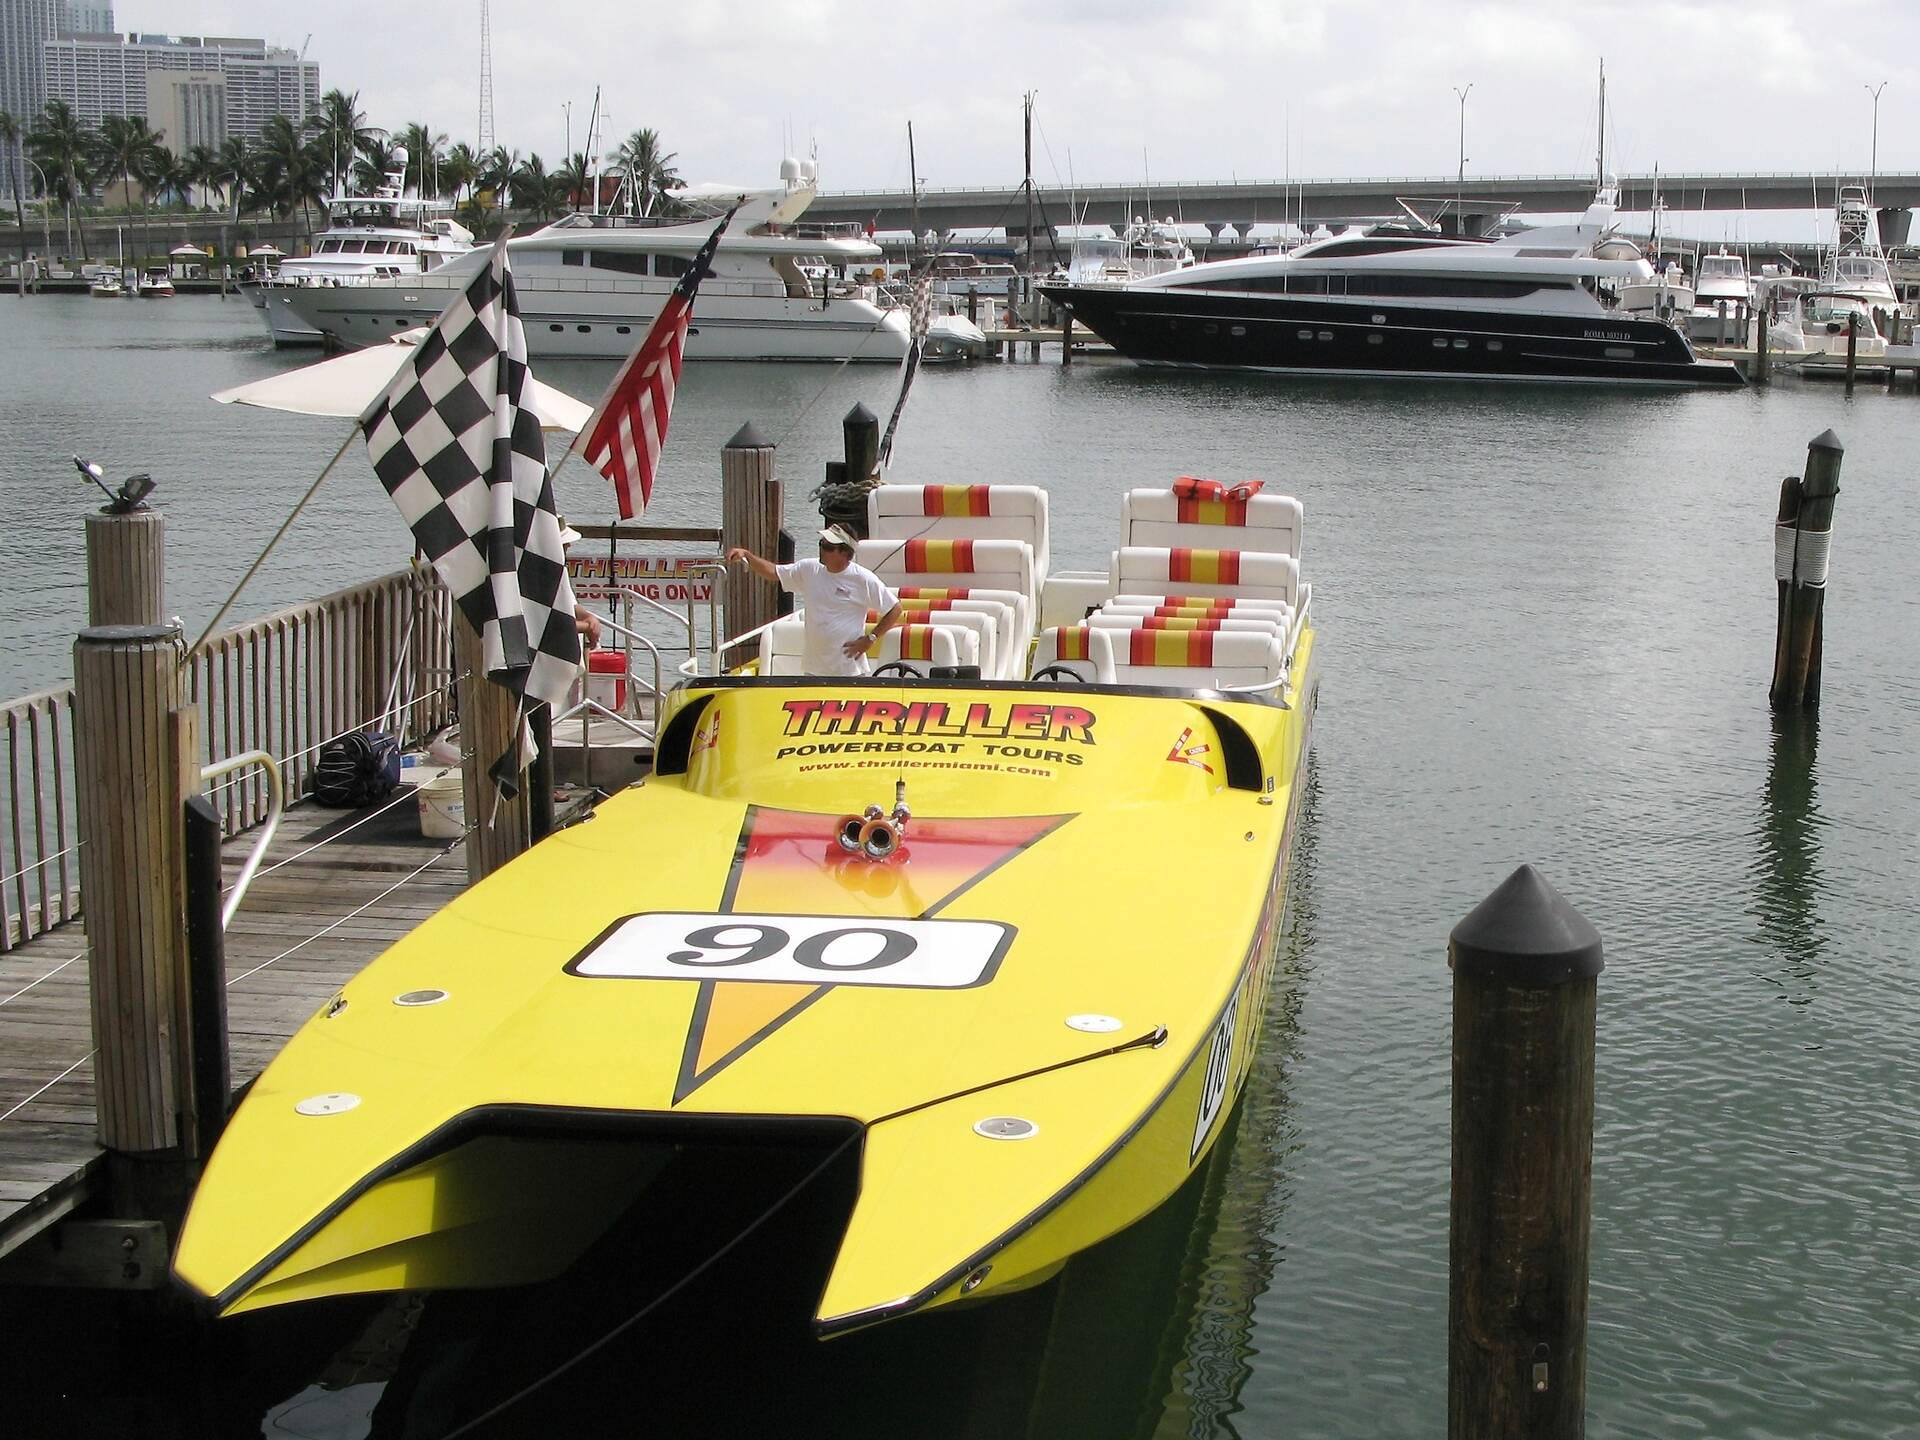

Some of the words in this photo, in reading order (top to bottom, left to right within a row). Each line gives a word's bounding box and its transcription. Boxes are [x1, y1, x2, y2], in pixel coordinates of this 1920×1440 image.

[1583, 330, 1605, 339] ROMA
[566, 557, 713, 579] THRILLER
[665, 584, 712, 600] ONLY
[782, 700, 1096, 745] THRILLER
[776, 742, 965, 759] POWERBOAT
[983, 744, 1084, 765] TOURS
[799, 760, 1051, 777] www.thrillermiami.com
[666, 924, 918, 971] 90
